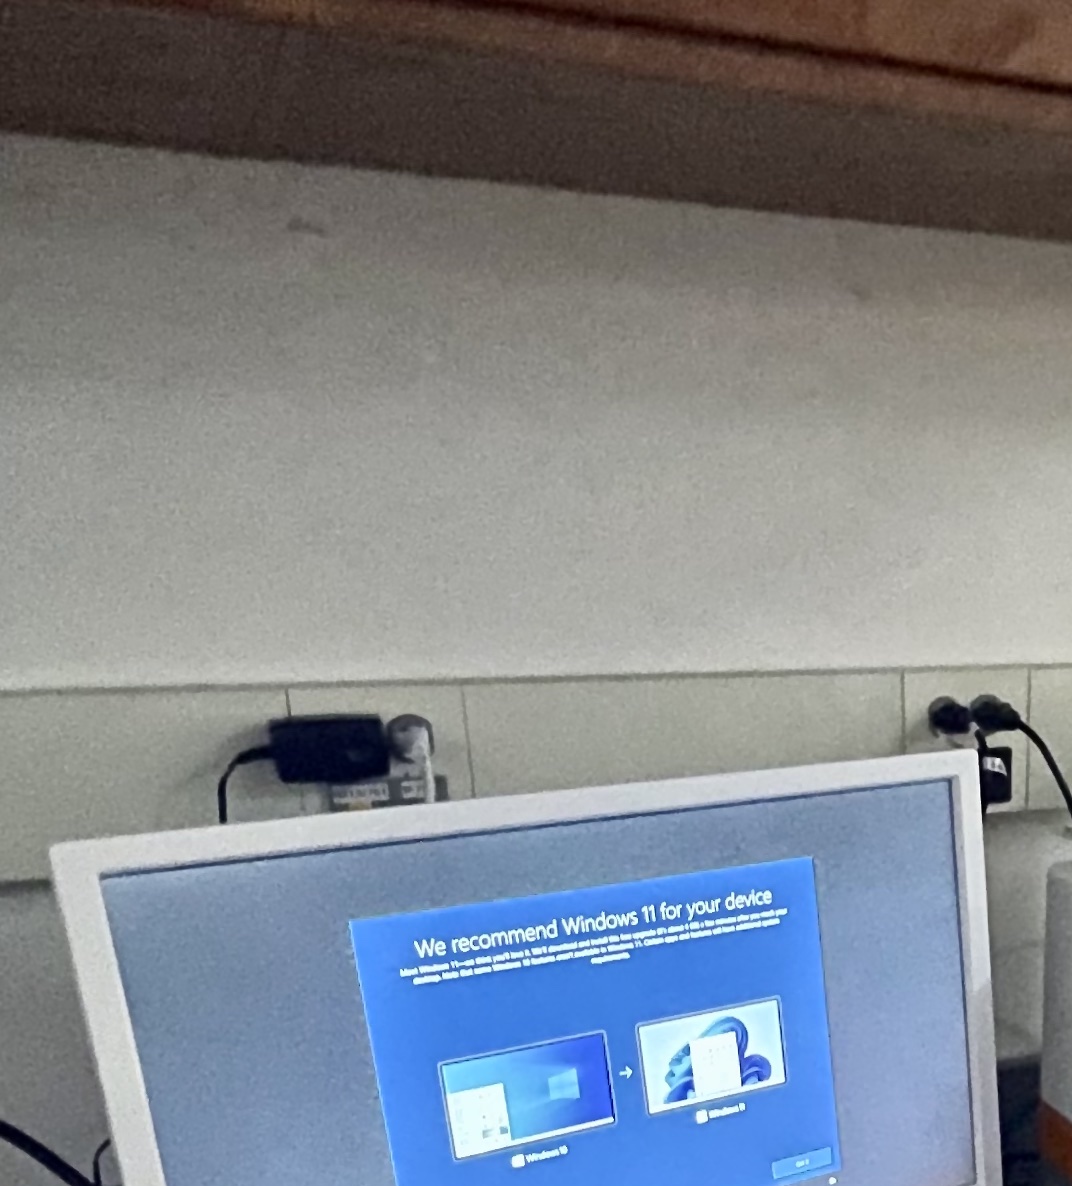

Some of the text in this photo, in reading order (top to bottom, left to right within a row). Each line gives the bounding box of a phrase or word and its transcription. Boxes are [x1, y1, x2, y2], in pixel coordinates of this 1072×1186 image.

[413, 889, 773, 959] We recommend Windows 11 for your device
